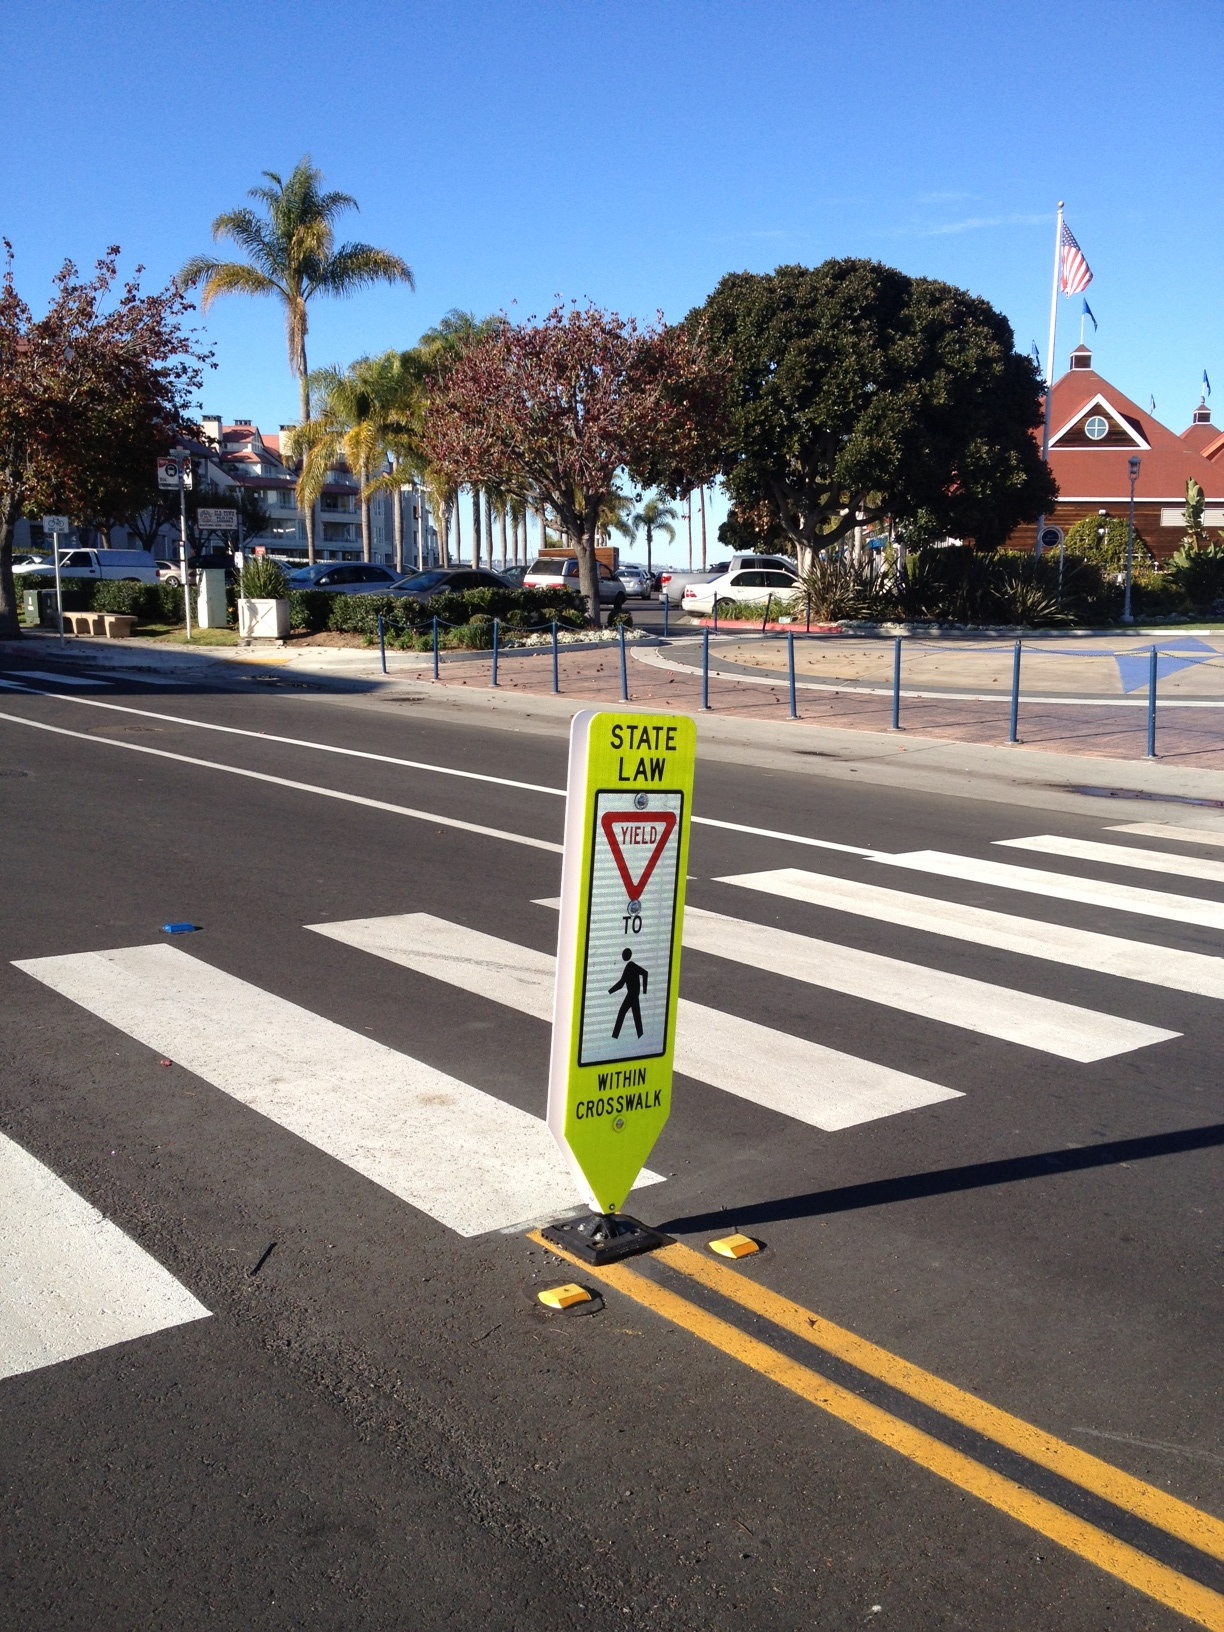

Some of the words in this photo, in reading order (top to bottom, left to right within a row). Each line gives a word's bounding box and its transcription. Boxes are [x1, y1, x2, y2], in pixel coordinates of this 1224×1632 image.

[610, 723, 678, 751] STATE
[618, 756, 666, 782] LAW
[620, 825, 658, 845] YIELD
[622, 915, 643, 935] TO
[598, 1067, 647, 1091] WITHIN
[576, 1089, 662, 1120] CROSSWALK
